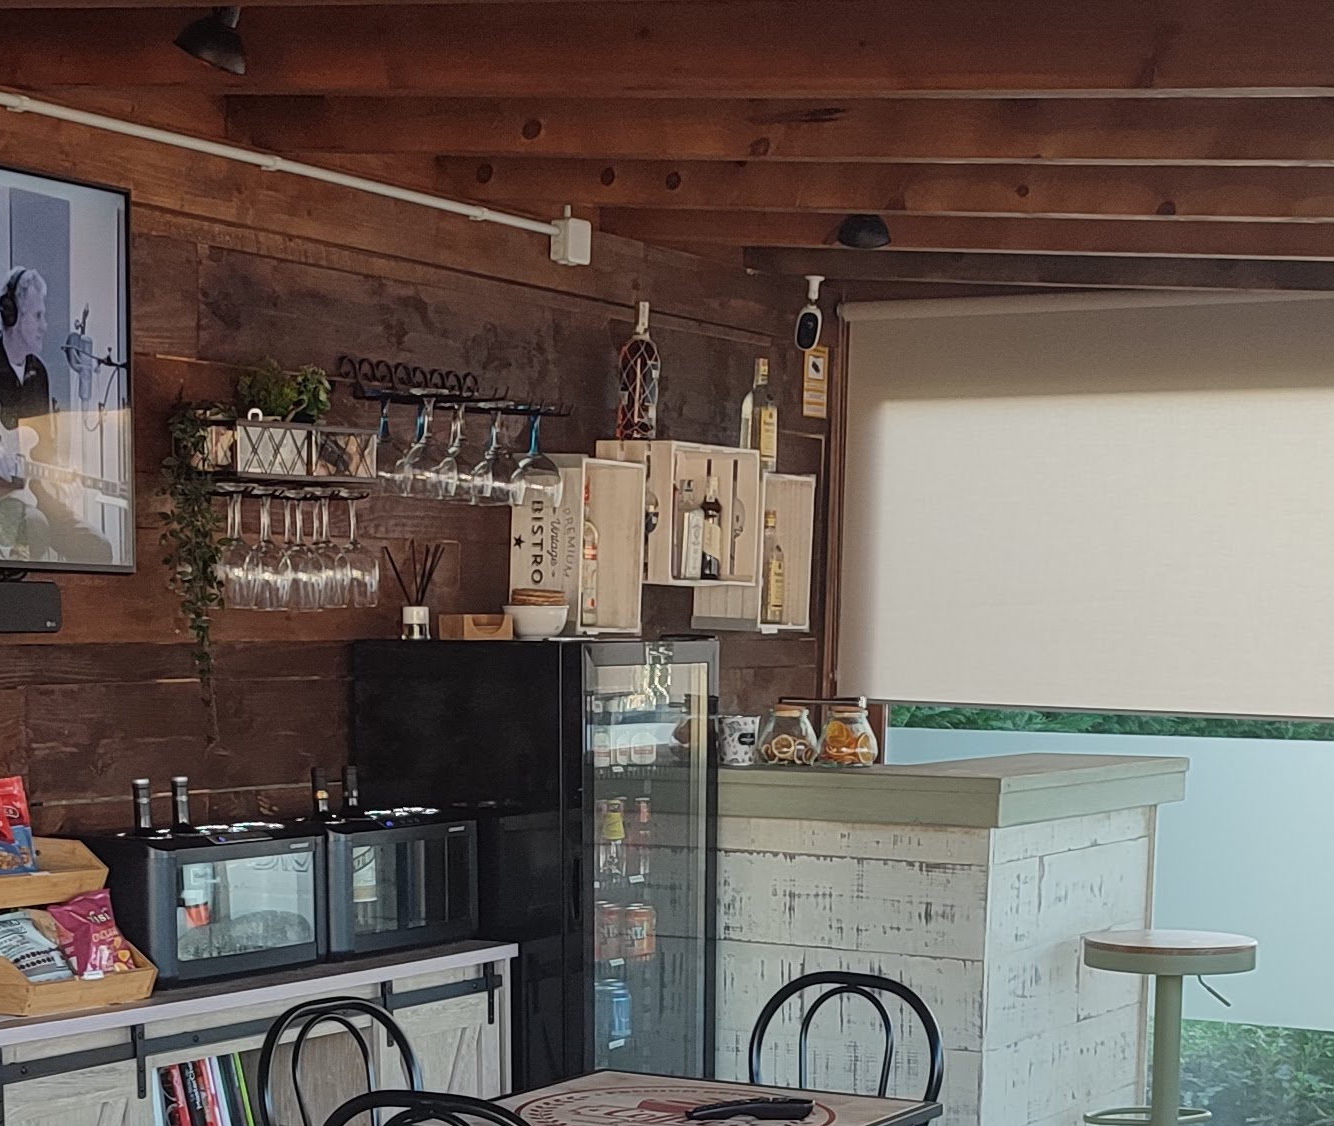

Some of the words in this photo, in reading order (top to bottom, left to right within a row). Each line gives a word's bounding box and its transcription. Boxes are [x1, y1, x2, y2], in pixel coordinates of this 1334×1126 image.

[531, 500, 544, 585] BISTRO
[546, 518, 561, 567] Vintage
[563, 508, 575, 577] PREMIUM
